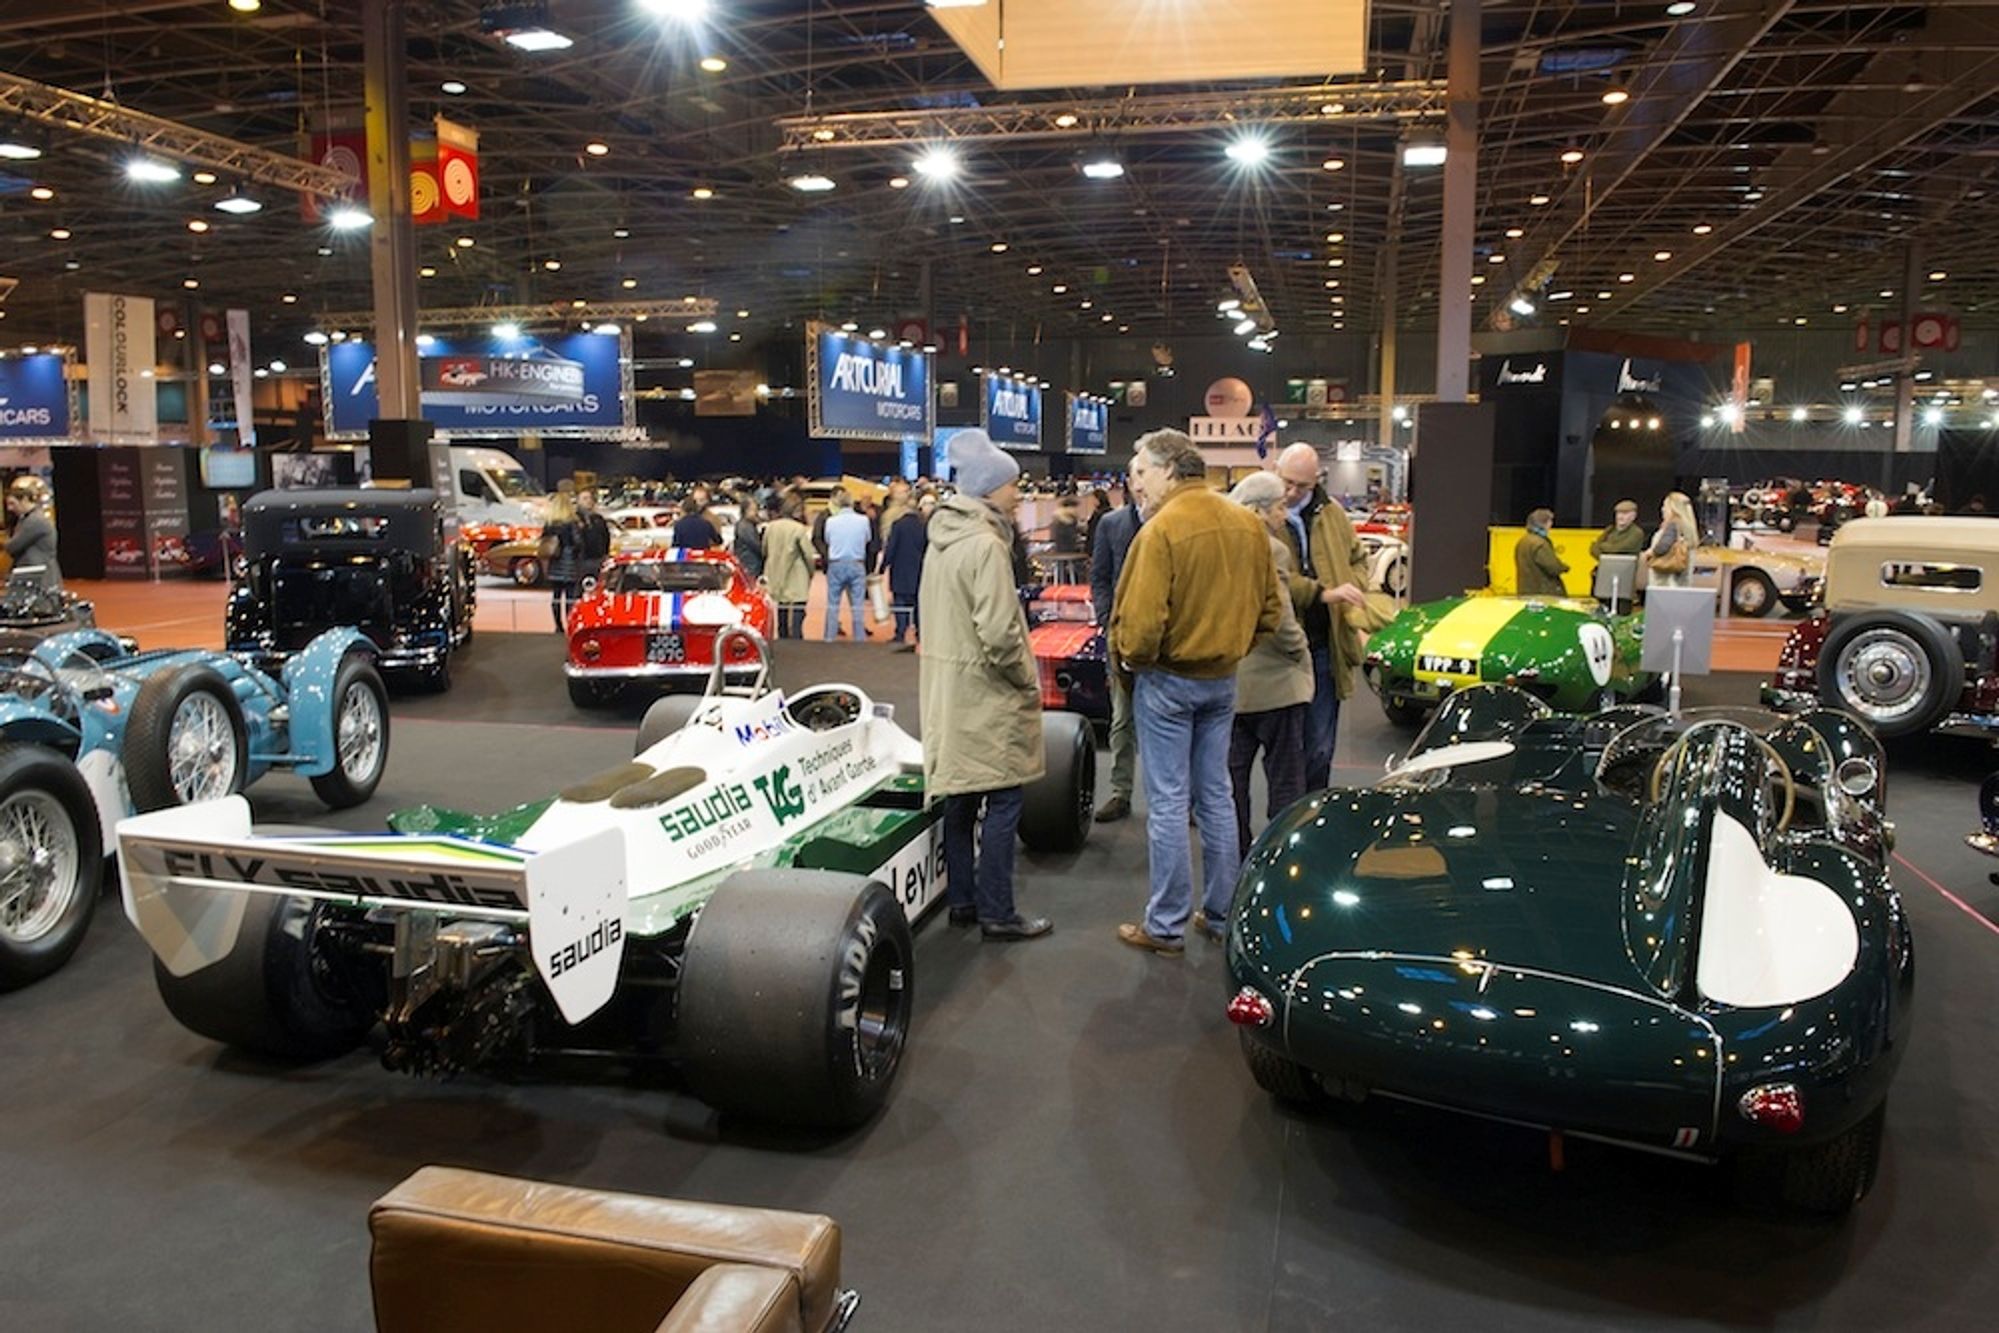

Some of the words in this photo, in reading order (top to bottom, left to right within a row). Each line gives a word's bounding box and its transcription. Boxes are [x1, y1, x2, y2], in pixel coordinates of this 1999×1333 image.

[114, 297, 128, 413] COLOURLOCK
[829, 352, 906, 399] ARTCURIAL
[1460, 658, 1471, 675] 9
[797, 738, 853, 777] Techniques
[819, 767, 849, 795] Avant
[659, 783, 753, 842] saudia
[686, 818, 752, 860] GOODYEAR
[892, 832, 946, 910] Leyla
[550, 917, 621, 979] saudia
